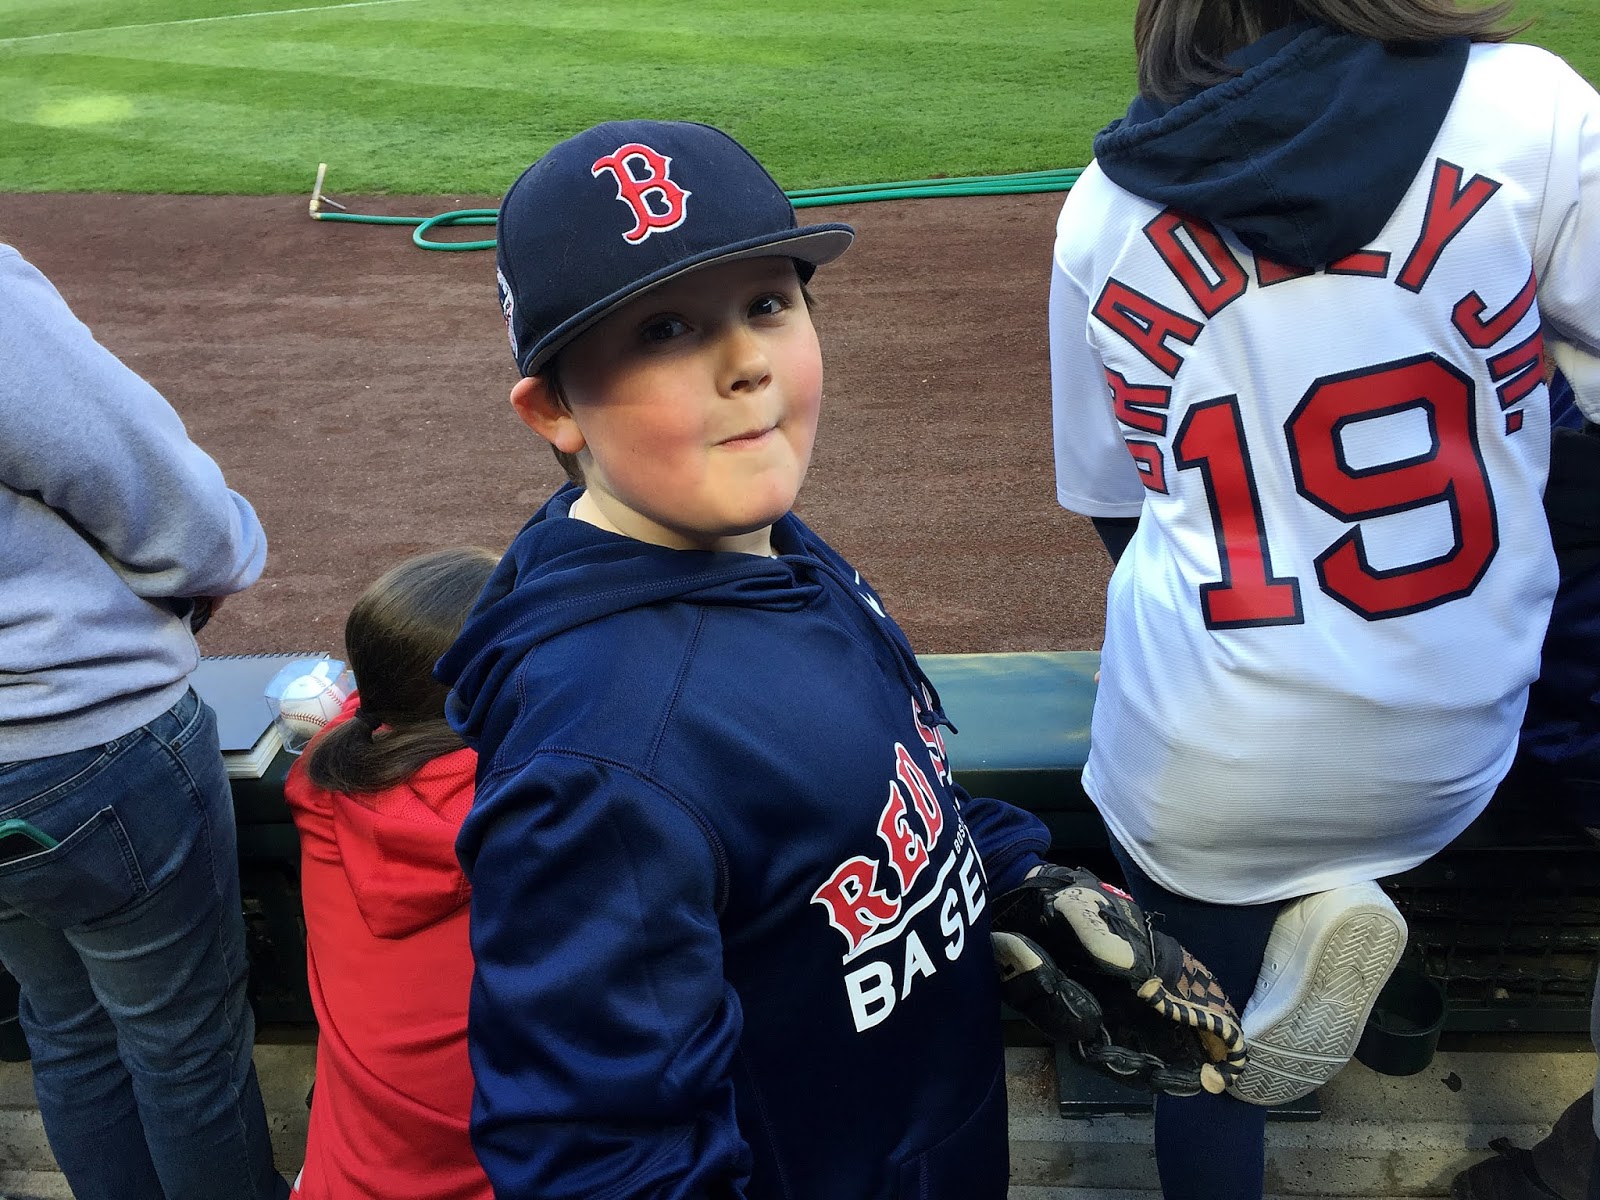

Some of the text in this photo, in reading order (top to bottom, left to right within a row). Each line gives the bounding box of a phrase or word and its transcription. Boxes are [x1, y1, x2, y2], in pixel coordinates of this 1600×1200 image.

[591, 143, 692, 245] B
[1091, 157, 1503, 495] BRADY
[1172, 351, 1500, 630] 19
[810, 741, 943, 956] RED
[843, 836, 988, 1033] BASE
